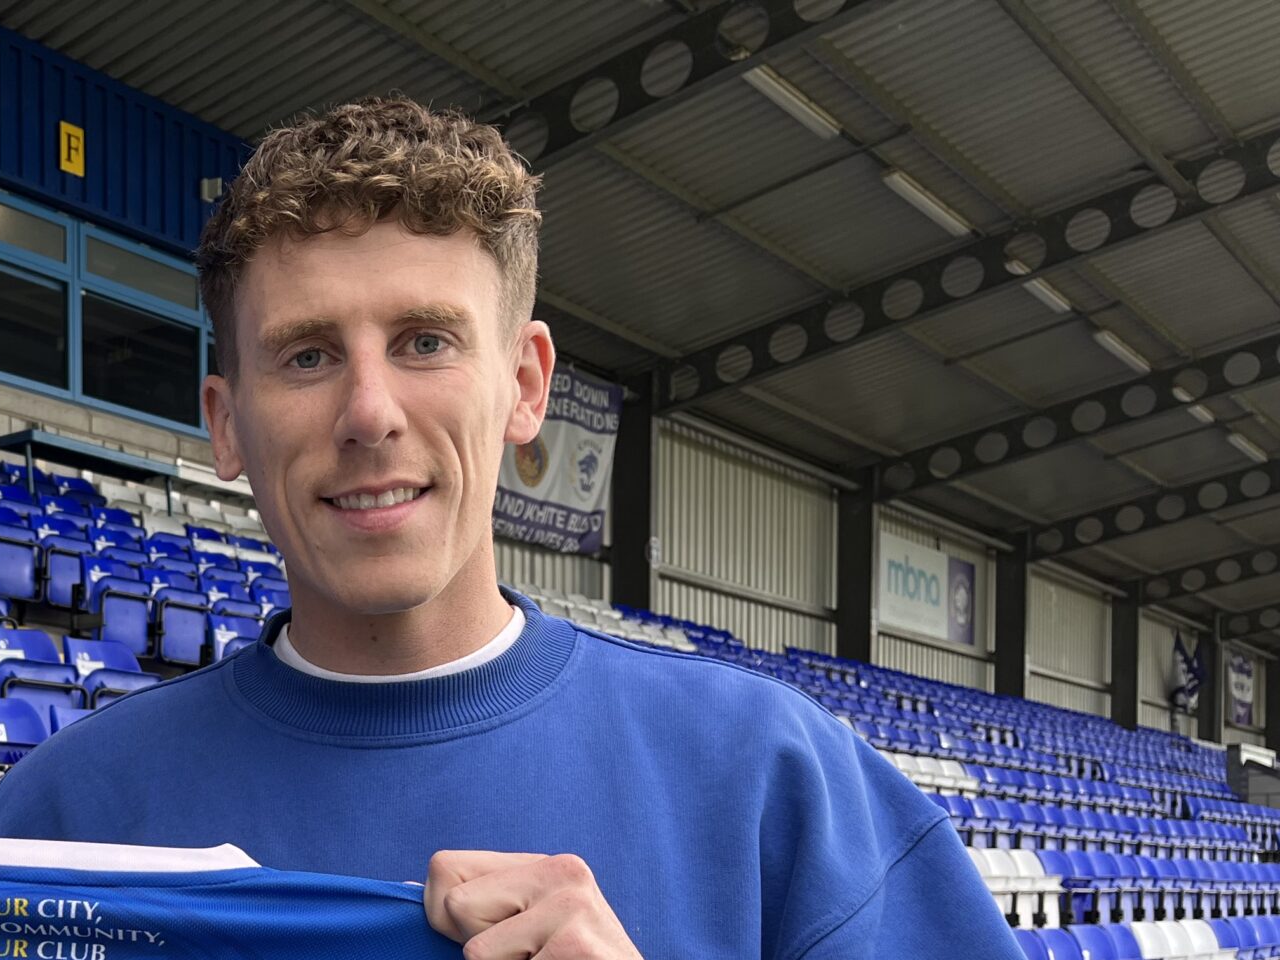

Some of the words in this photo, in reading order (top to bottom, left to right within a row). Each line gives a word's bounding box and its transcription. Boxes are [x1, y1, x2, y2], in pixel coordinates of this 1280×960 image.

[64, 132, 81, 163] F
[572, 380, 610, 409] DOWN
[887, 555, 940, 607] mbna
[37, 898, 102, 924] CITY,
